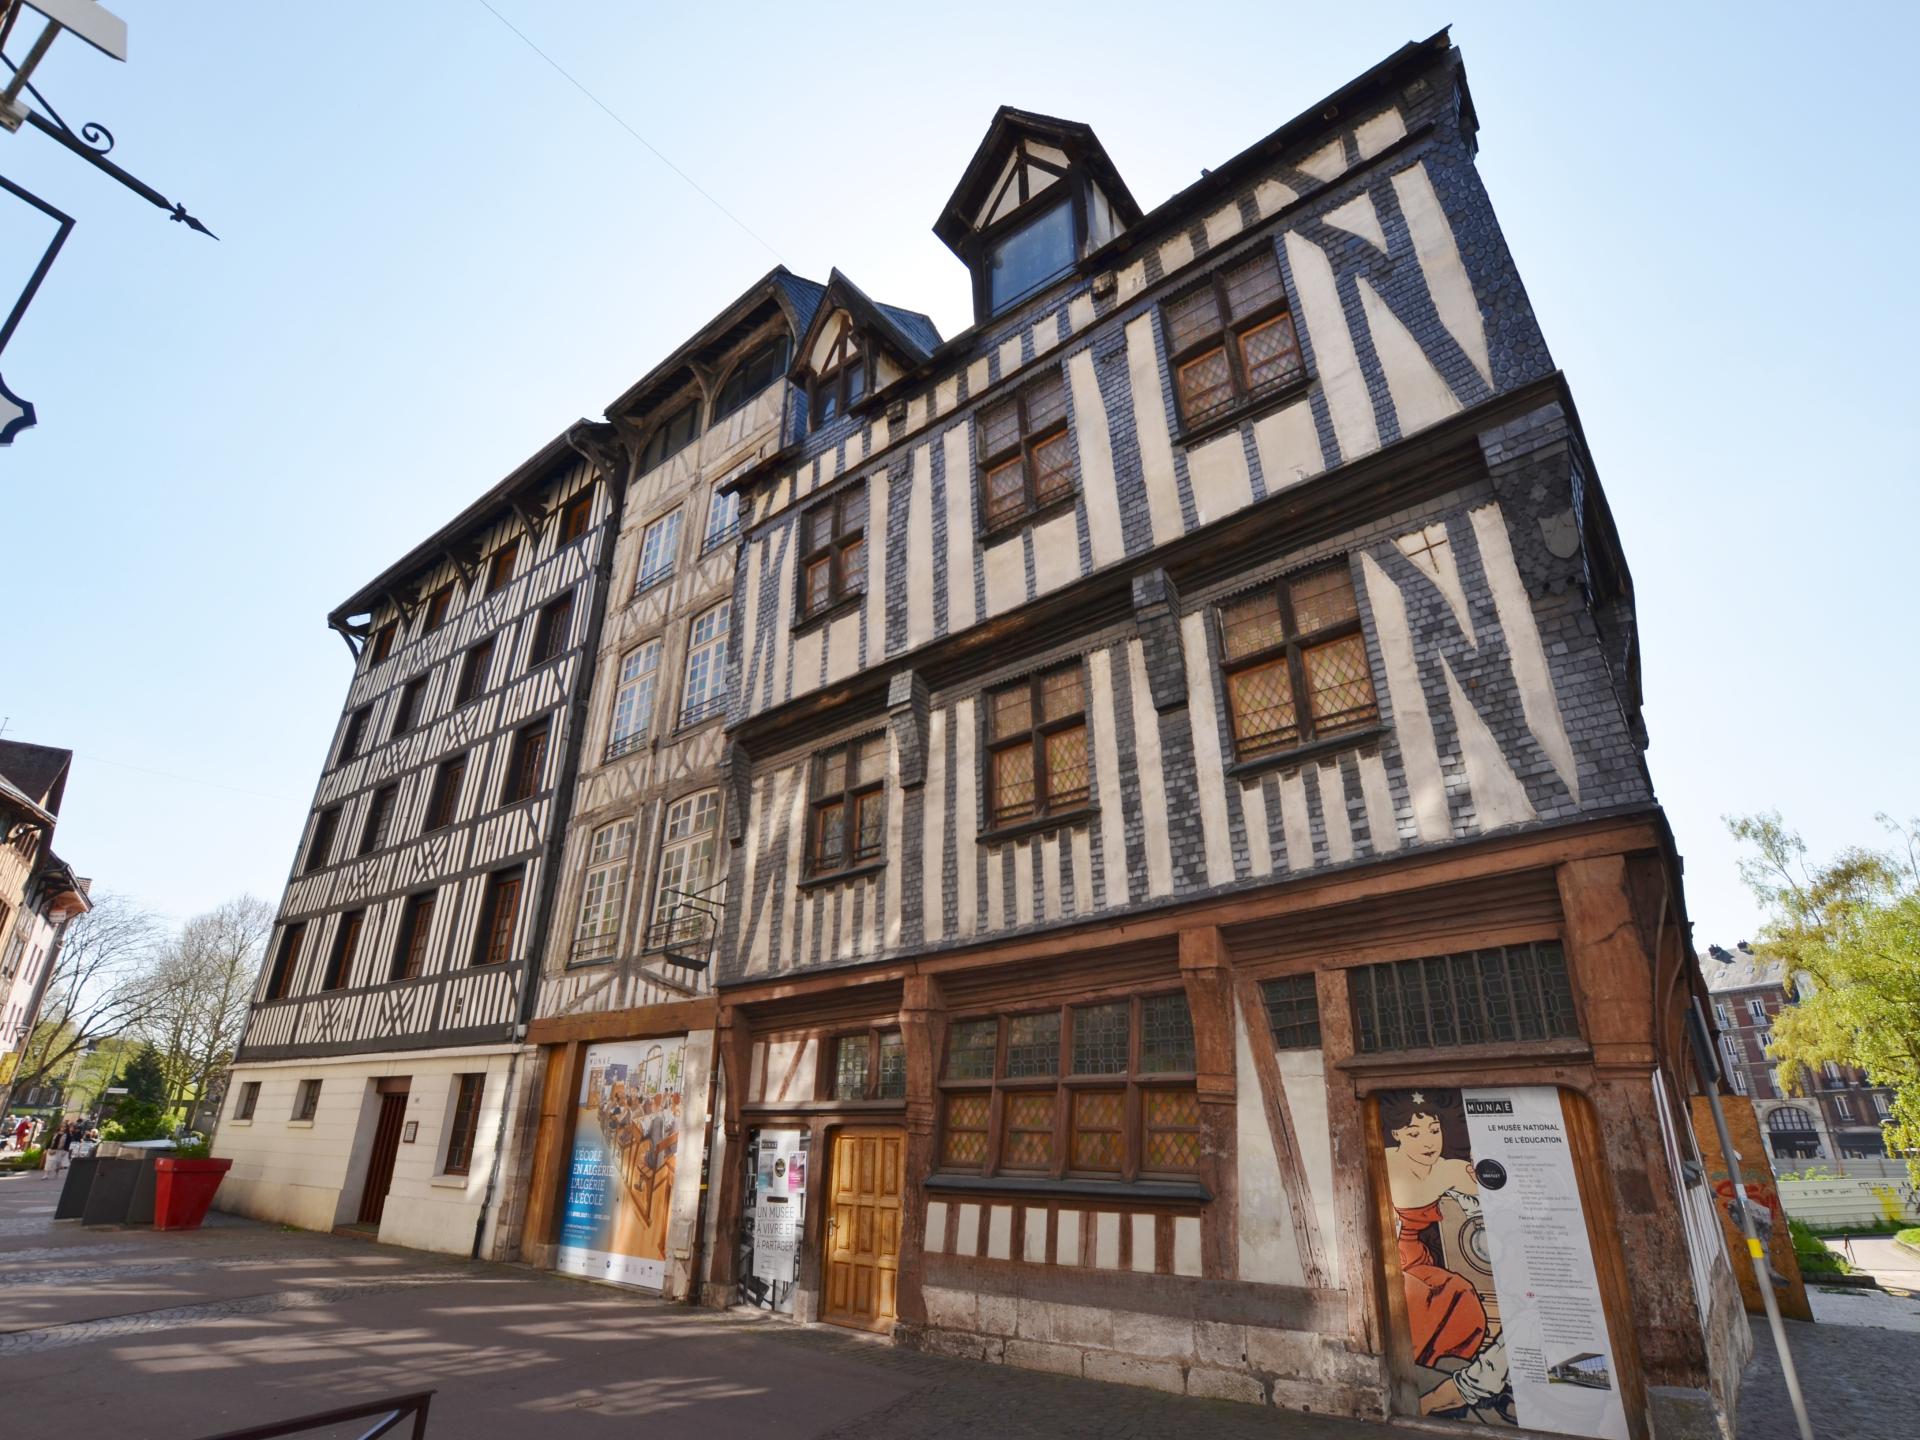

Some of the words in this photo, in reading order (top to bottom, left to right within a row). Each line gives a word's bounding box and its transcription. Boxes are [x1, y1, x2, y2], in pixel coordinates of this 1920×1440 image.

[1488, 1124, 1496, 1132] LE
[1497, 1123, 1522, 1132] MUSÉE
[1514, 1136, 1562, 1144] L'ÉDUCATION
[575, 1147, 603, 1161] L'ÉCOLE
[573, 1163, 583, 1175] EN
[583, 1161, 615, 1177] ALGÉRIE
[575, 1190, 604, 1206] L'ÉCOLE
[757, 1206, 767, 1218] UN
[763, 1223, 783, 1235] VIVRE
[785, 1224, 795, 1235] ET
[761, 1240, 794, 1252] PARTAGER
